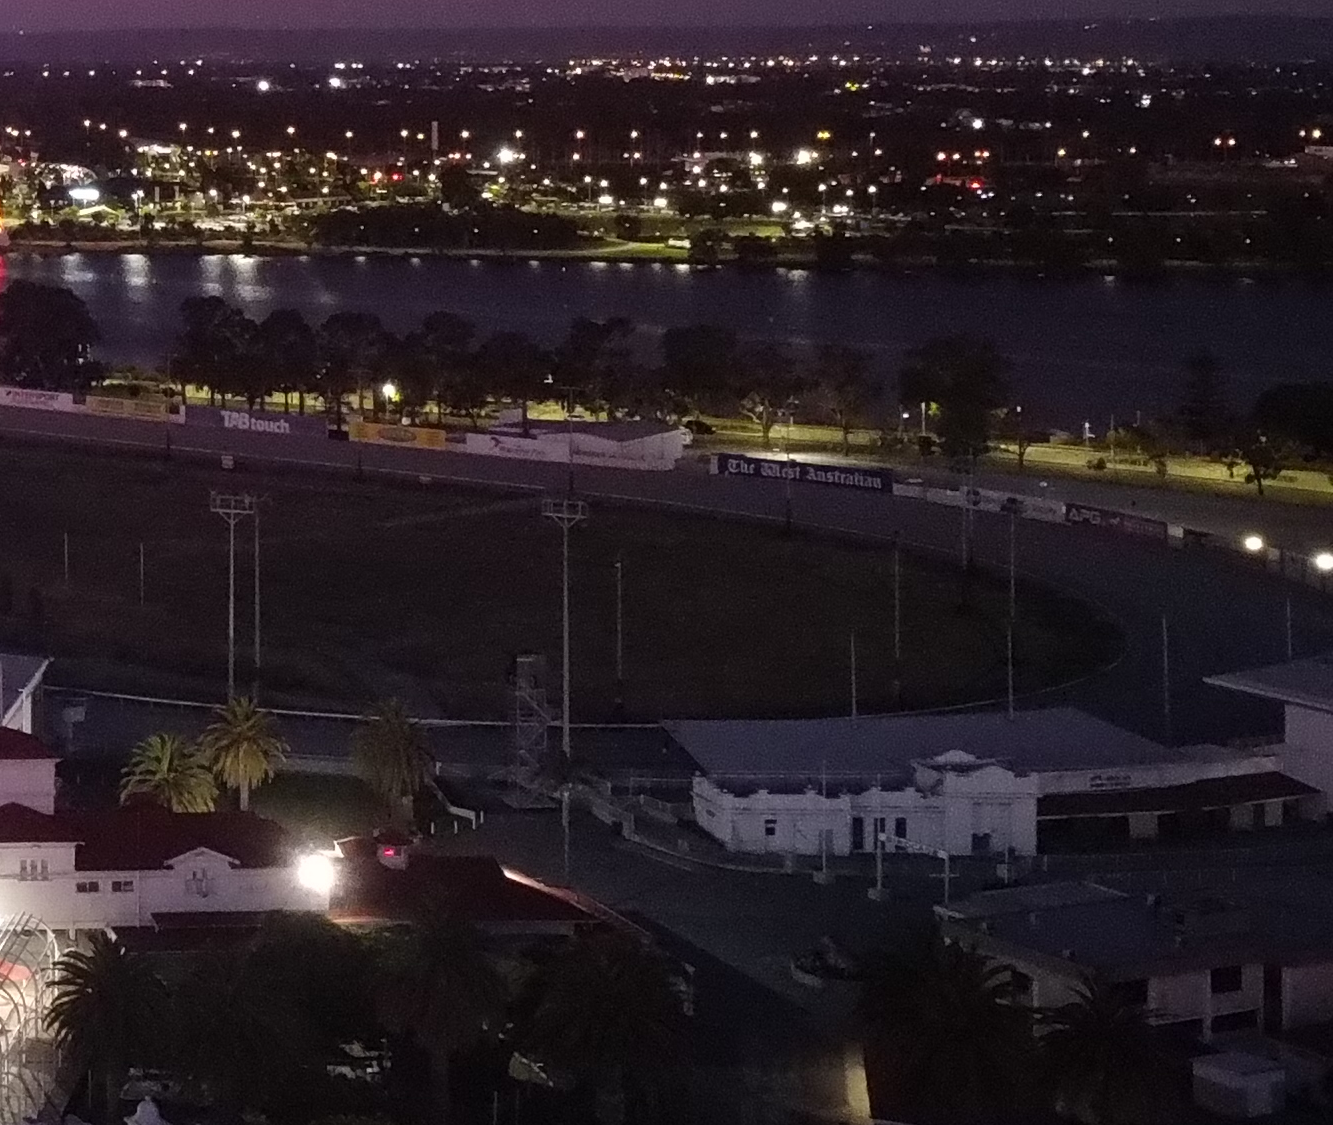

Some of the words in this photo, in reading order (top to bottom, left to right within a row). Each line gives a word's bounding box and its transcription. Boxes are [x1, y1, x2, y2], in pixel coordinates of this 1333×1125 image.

[727, 458, 755, 474] The
[760, 460, 801, 479] West
[806, 467, 883, 489] Australian
